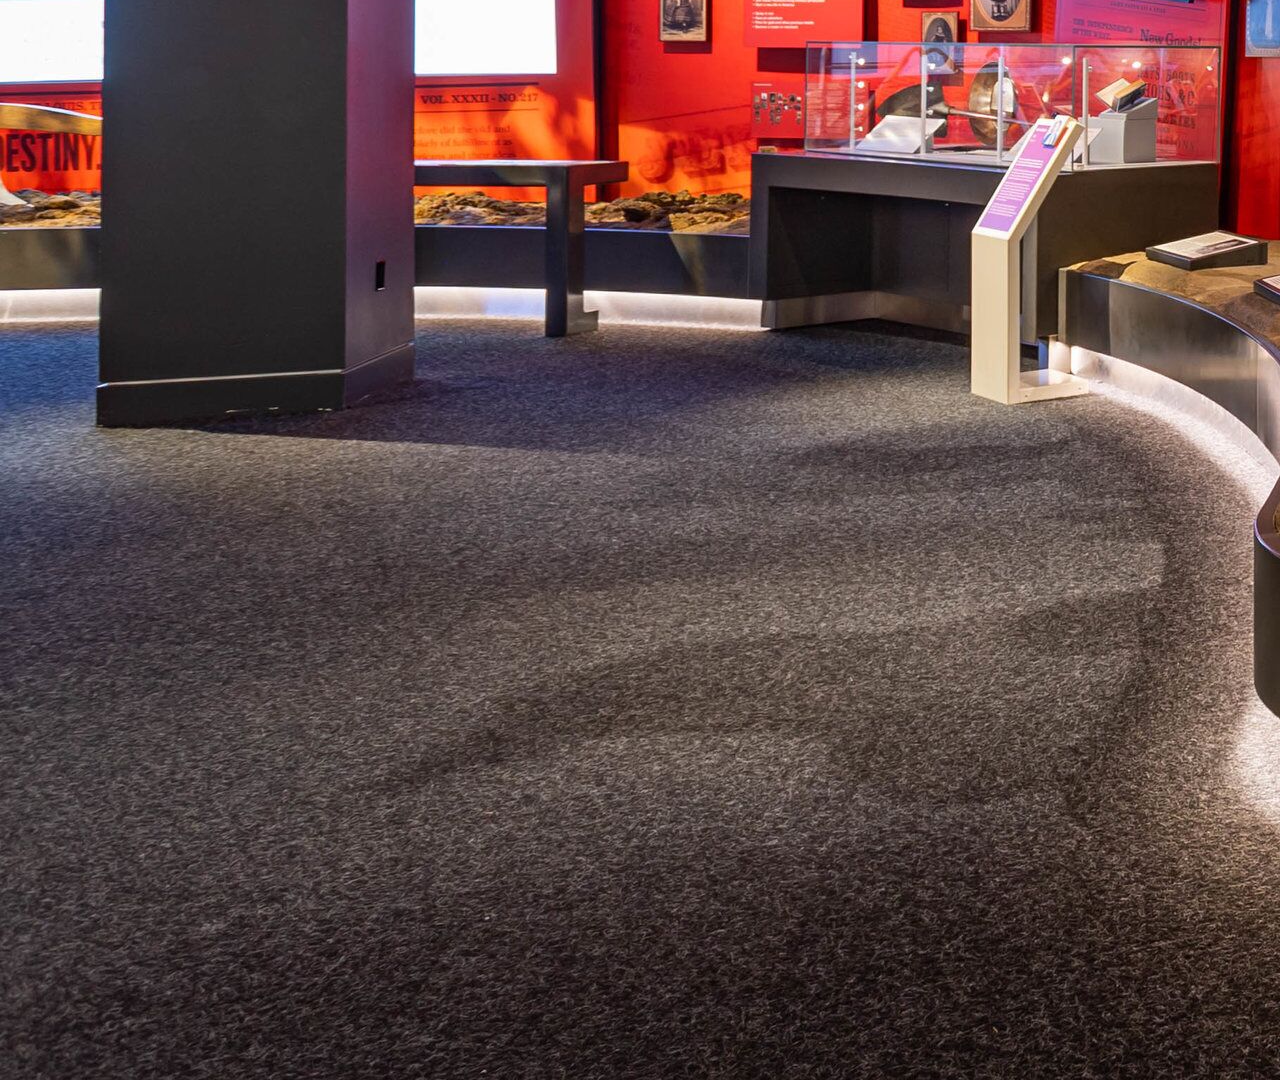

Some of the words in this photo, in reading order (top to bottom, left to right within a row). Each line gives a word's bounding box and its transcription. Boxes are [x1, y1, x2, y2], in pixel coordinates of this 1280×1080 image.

[1140, 28, 1165, 42] New
[420, 94, 448, 105] VOL.
[450, 93, 490, 104] XXXII
